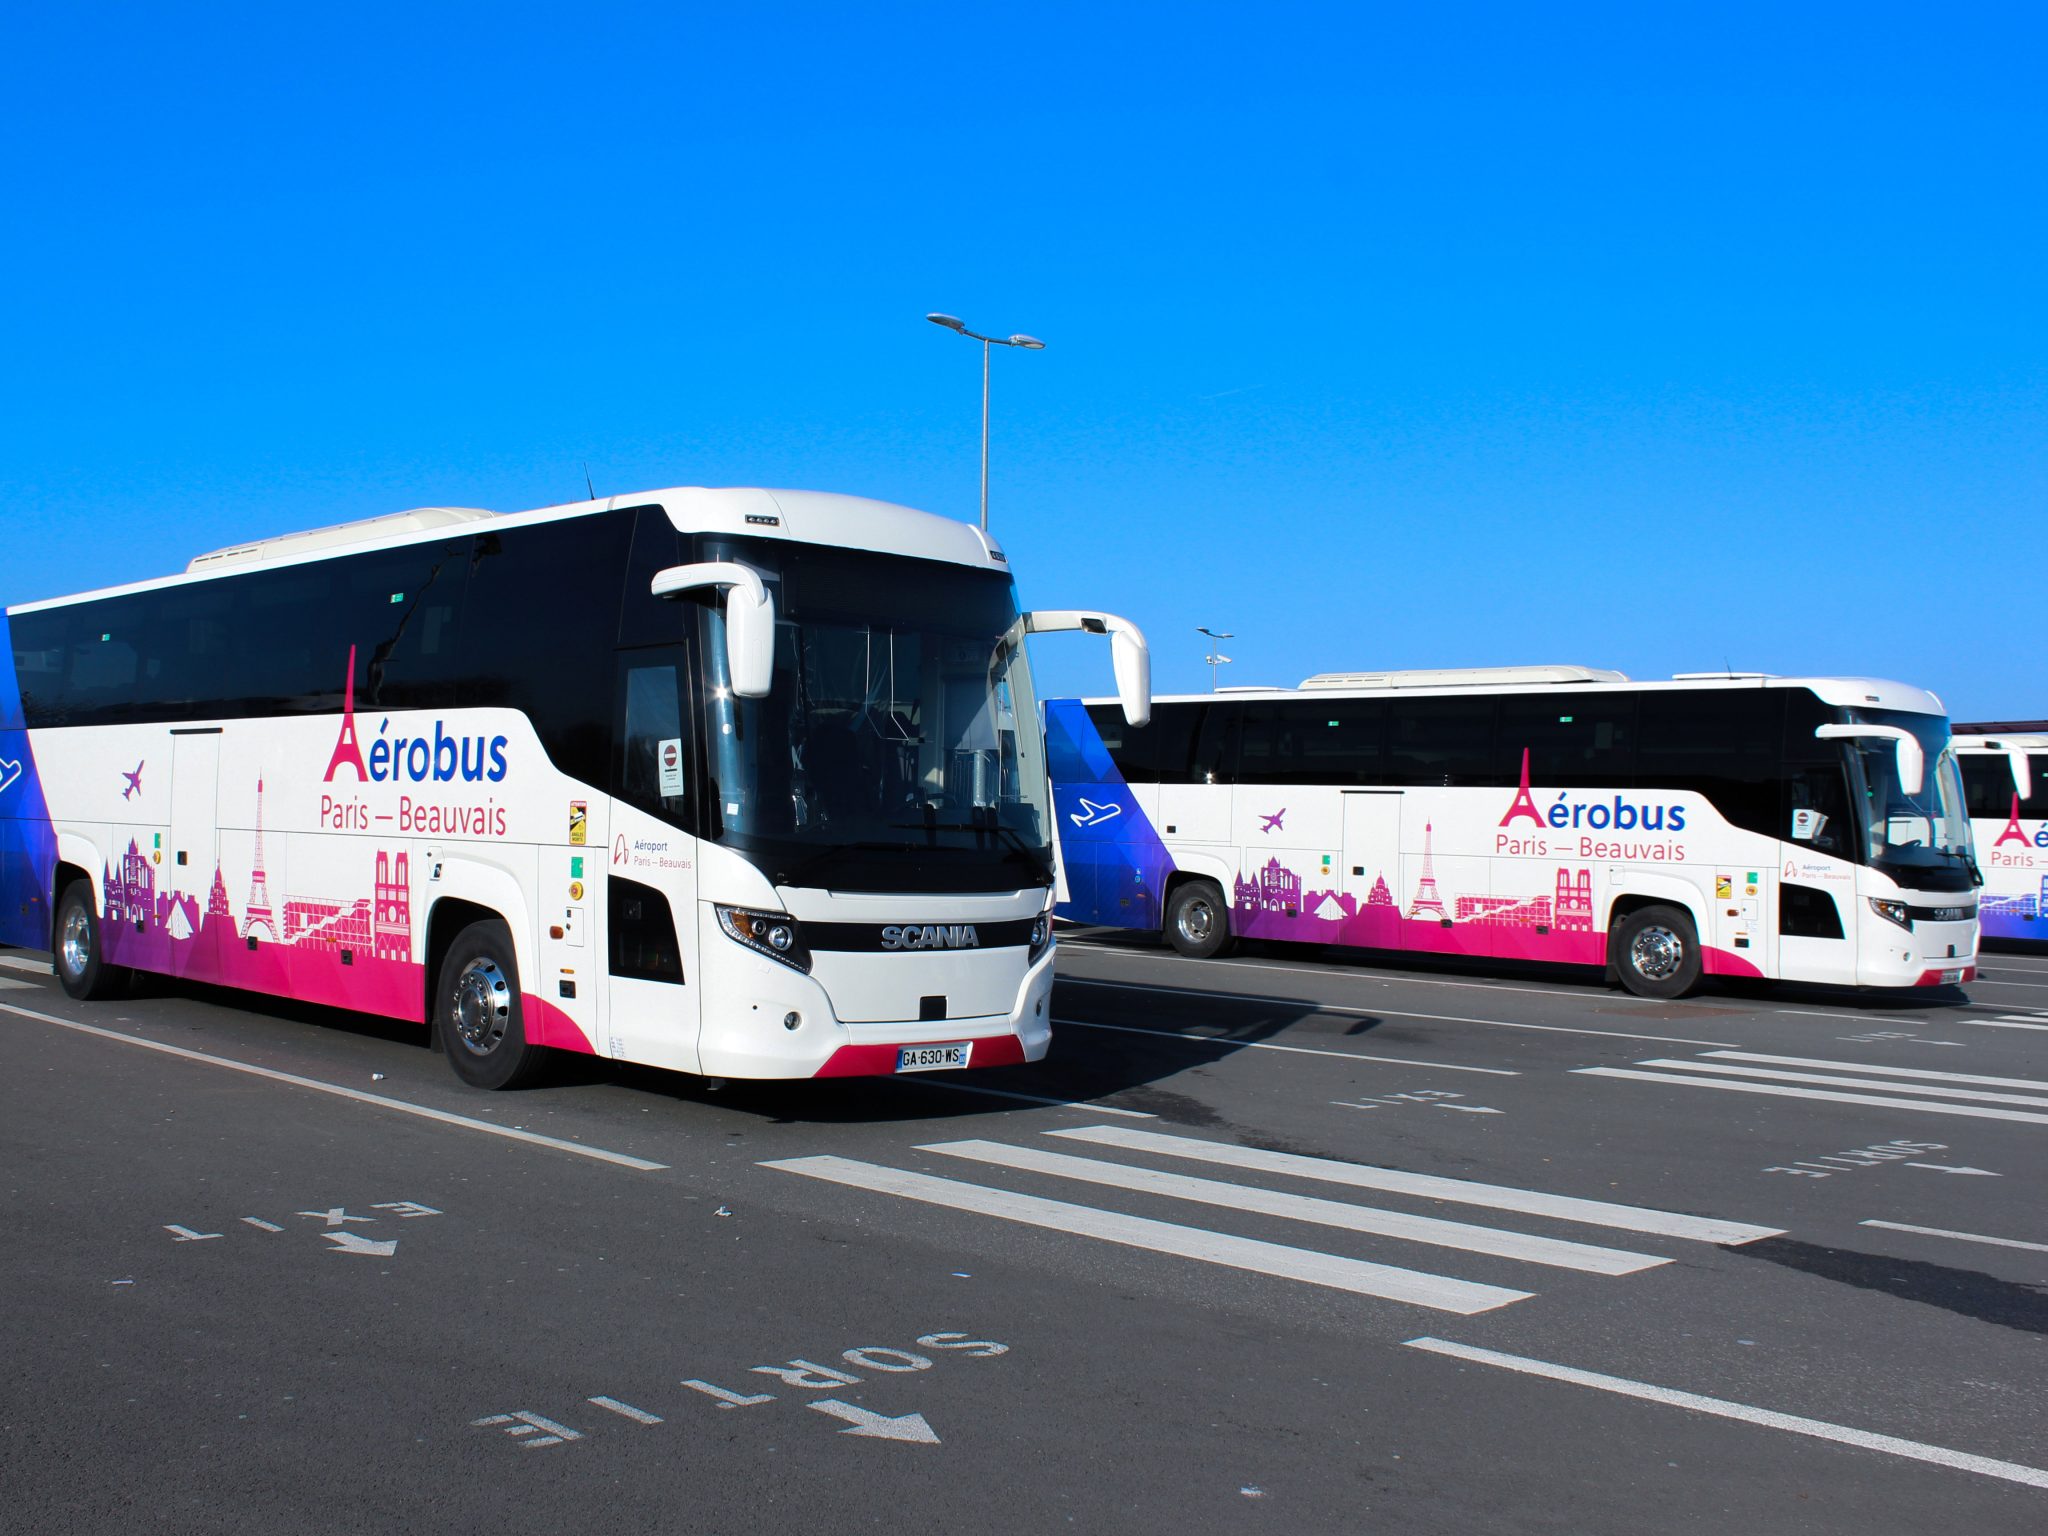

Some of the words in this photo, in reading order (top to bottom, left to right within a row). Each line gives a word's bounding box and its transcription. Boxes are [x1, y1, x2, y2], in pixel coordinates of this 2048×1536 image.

[1498, 747, 1686, 831] Aérobus
[320, 795, 368, 830] Paris
[400, 796, 507, 836] Beauvais
[634, 840, 668, 853] Aéroport
[1496, 834, 1547, 856] Paris
[1580, 837, 1685, 861] Beauvais
[1991, 851, 2034, 867] Paris
[634, 855, 651, 867] Paris
[659, 857, 692, 869] Beauvais
[881, 925, 980, 949] SCANIA
[470, 1332, 1010, 1448] SORTIE
